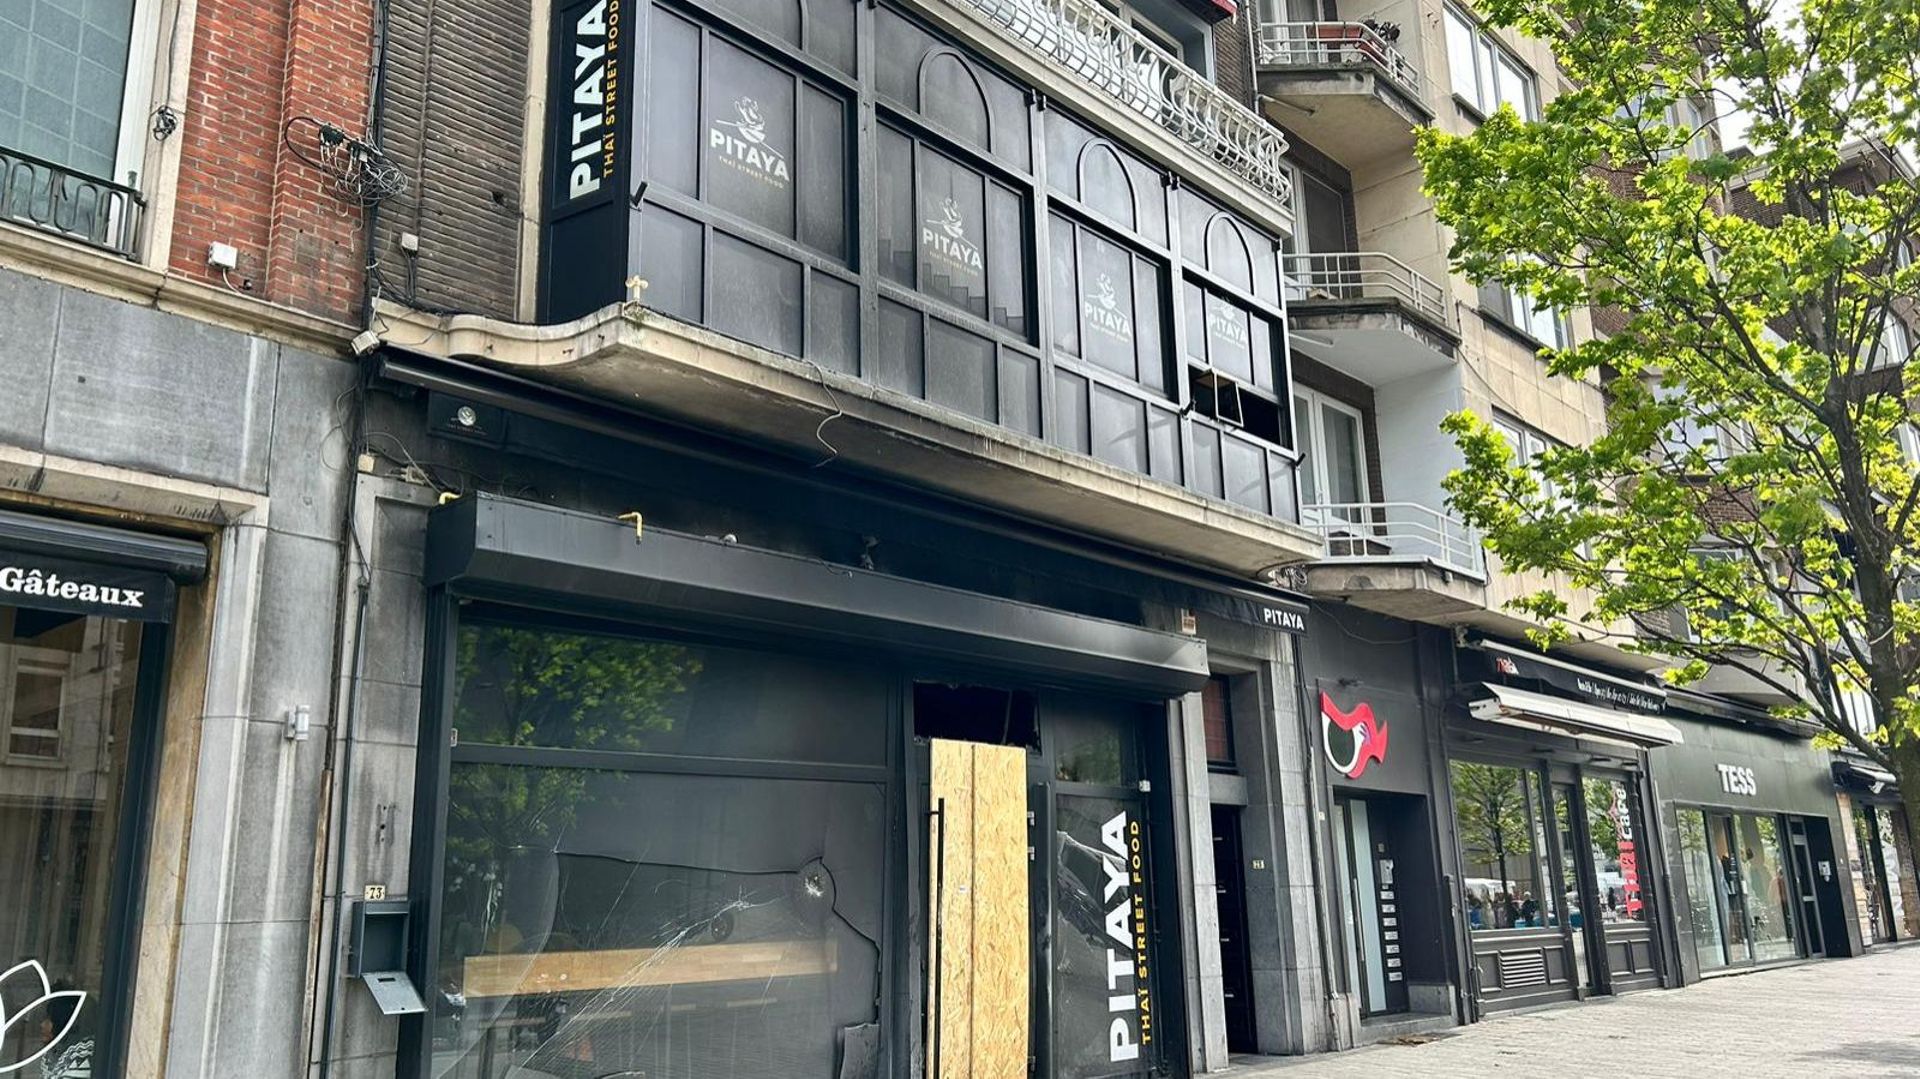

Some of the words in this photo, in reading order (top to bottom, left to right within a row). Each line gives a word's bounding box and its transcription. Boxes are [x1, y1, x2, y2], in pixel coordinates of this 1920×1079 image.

[608, 0, 620, 51] FOOD
[570, 0, 607, 200] PITAYA
[605, 59, 617, 125] STREET
[711, 128, 790, 182] PITAYA
[922, 227, 983, 270] PITAYA
[1084, 301, 1132, 337] PITAYA
[1209, 312, 1248, 345] PITAYA
[0, 567, 145, 608] Gâteaux
[1263, 607, 1305, 631] PITAYA
[1716, 763, 1757, 796] TESS
[1130, 820, 1143, 883] FOOD
[369, 886, 384, 900] 73
[1101, 810, 1139, 1063] PITAYA
[1134, 894, 1149, 979] STREET
